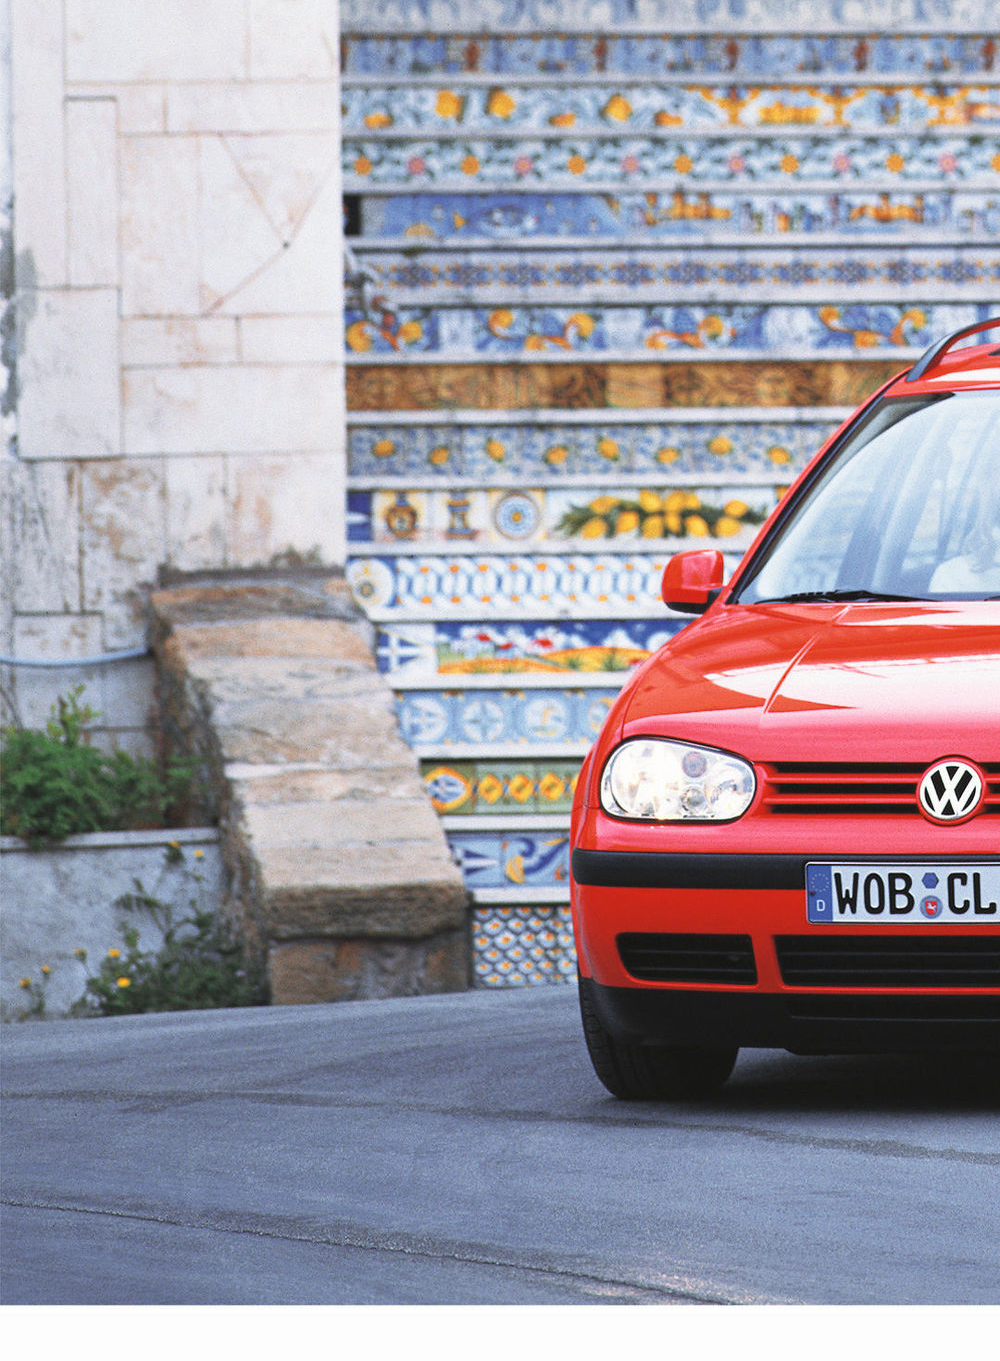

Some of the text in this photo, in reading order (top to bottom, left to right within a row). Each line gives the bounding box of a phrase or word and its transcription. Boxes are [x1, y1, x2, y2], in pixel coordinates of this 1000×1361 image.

[921, 763, 981, 819] VW
[816, 898, 827, 912] D
[833, 871, 916, 915] WOB
